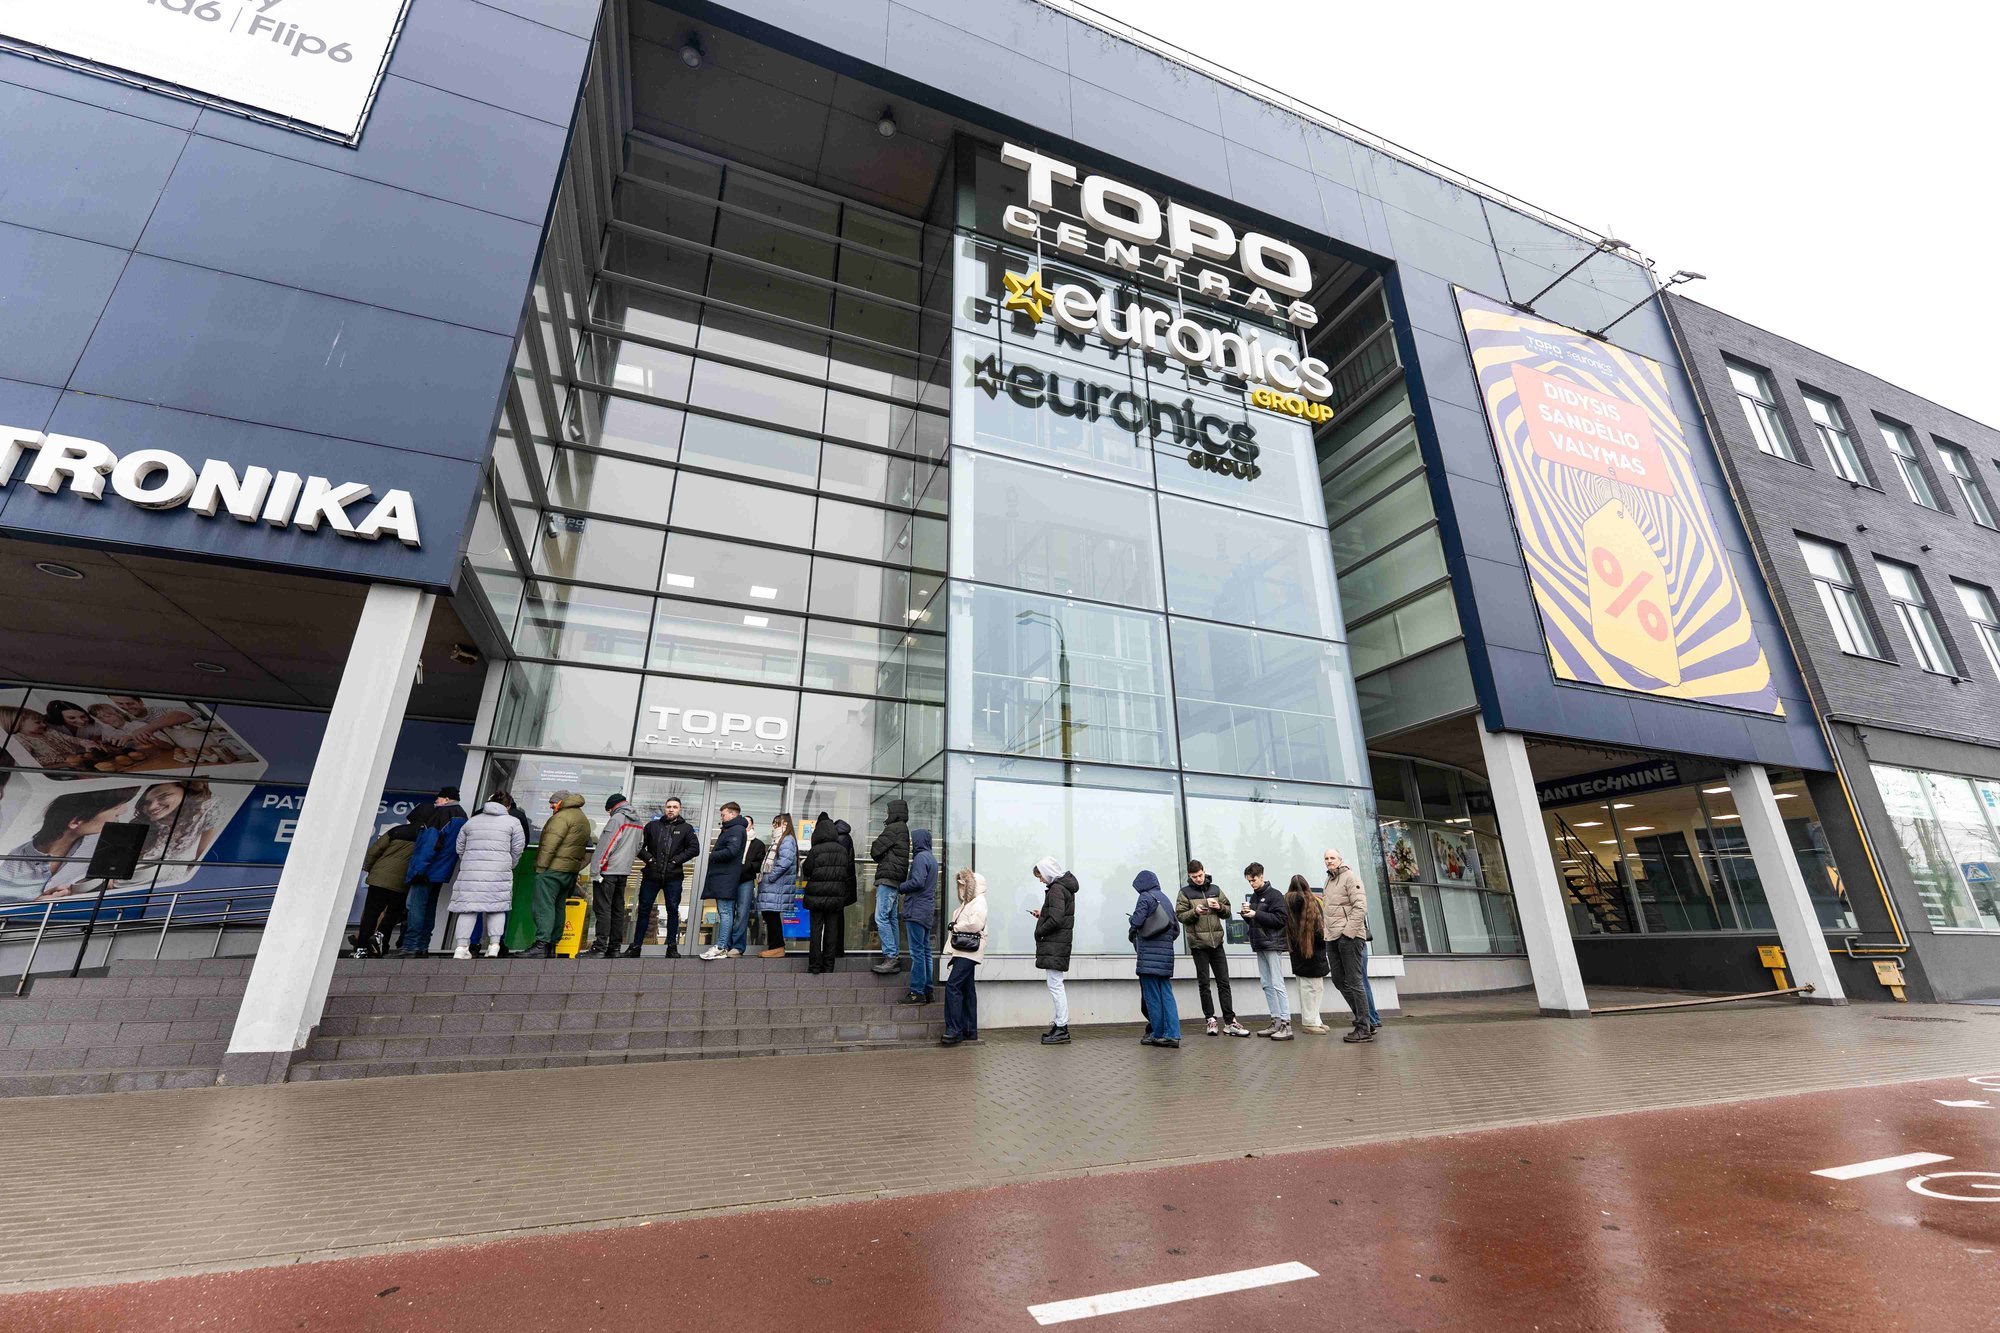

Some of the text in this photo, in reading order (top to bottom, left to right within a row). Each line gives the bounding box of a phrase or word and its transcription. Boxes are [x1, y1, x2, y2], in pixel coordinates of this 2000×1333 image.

[247, 14, 353, 63] Flip6
[1001, 141, 1312, 298] TOPO
[1003, 204, 1319, 329] CENTRAS
[1051, 283, 1334, 401] euronics
[1526, 335, 1562, 355] TOPO
[1252, 388, 1334, 424] GROUP
[1543, 381, 1621, 421] DIDYSIS
[1538, 403, 1640, 450] SANDĖLIO
[1547, 430, 1646, 476] VALYMAS
[0, 424, 422, 547] TRONIKA
[644, 734, 786, 755] CENTRAS
[649, 705, 788, 740] TOPO
